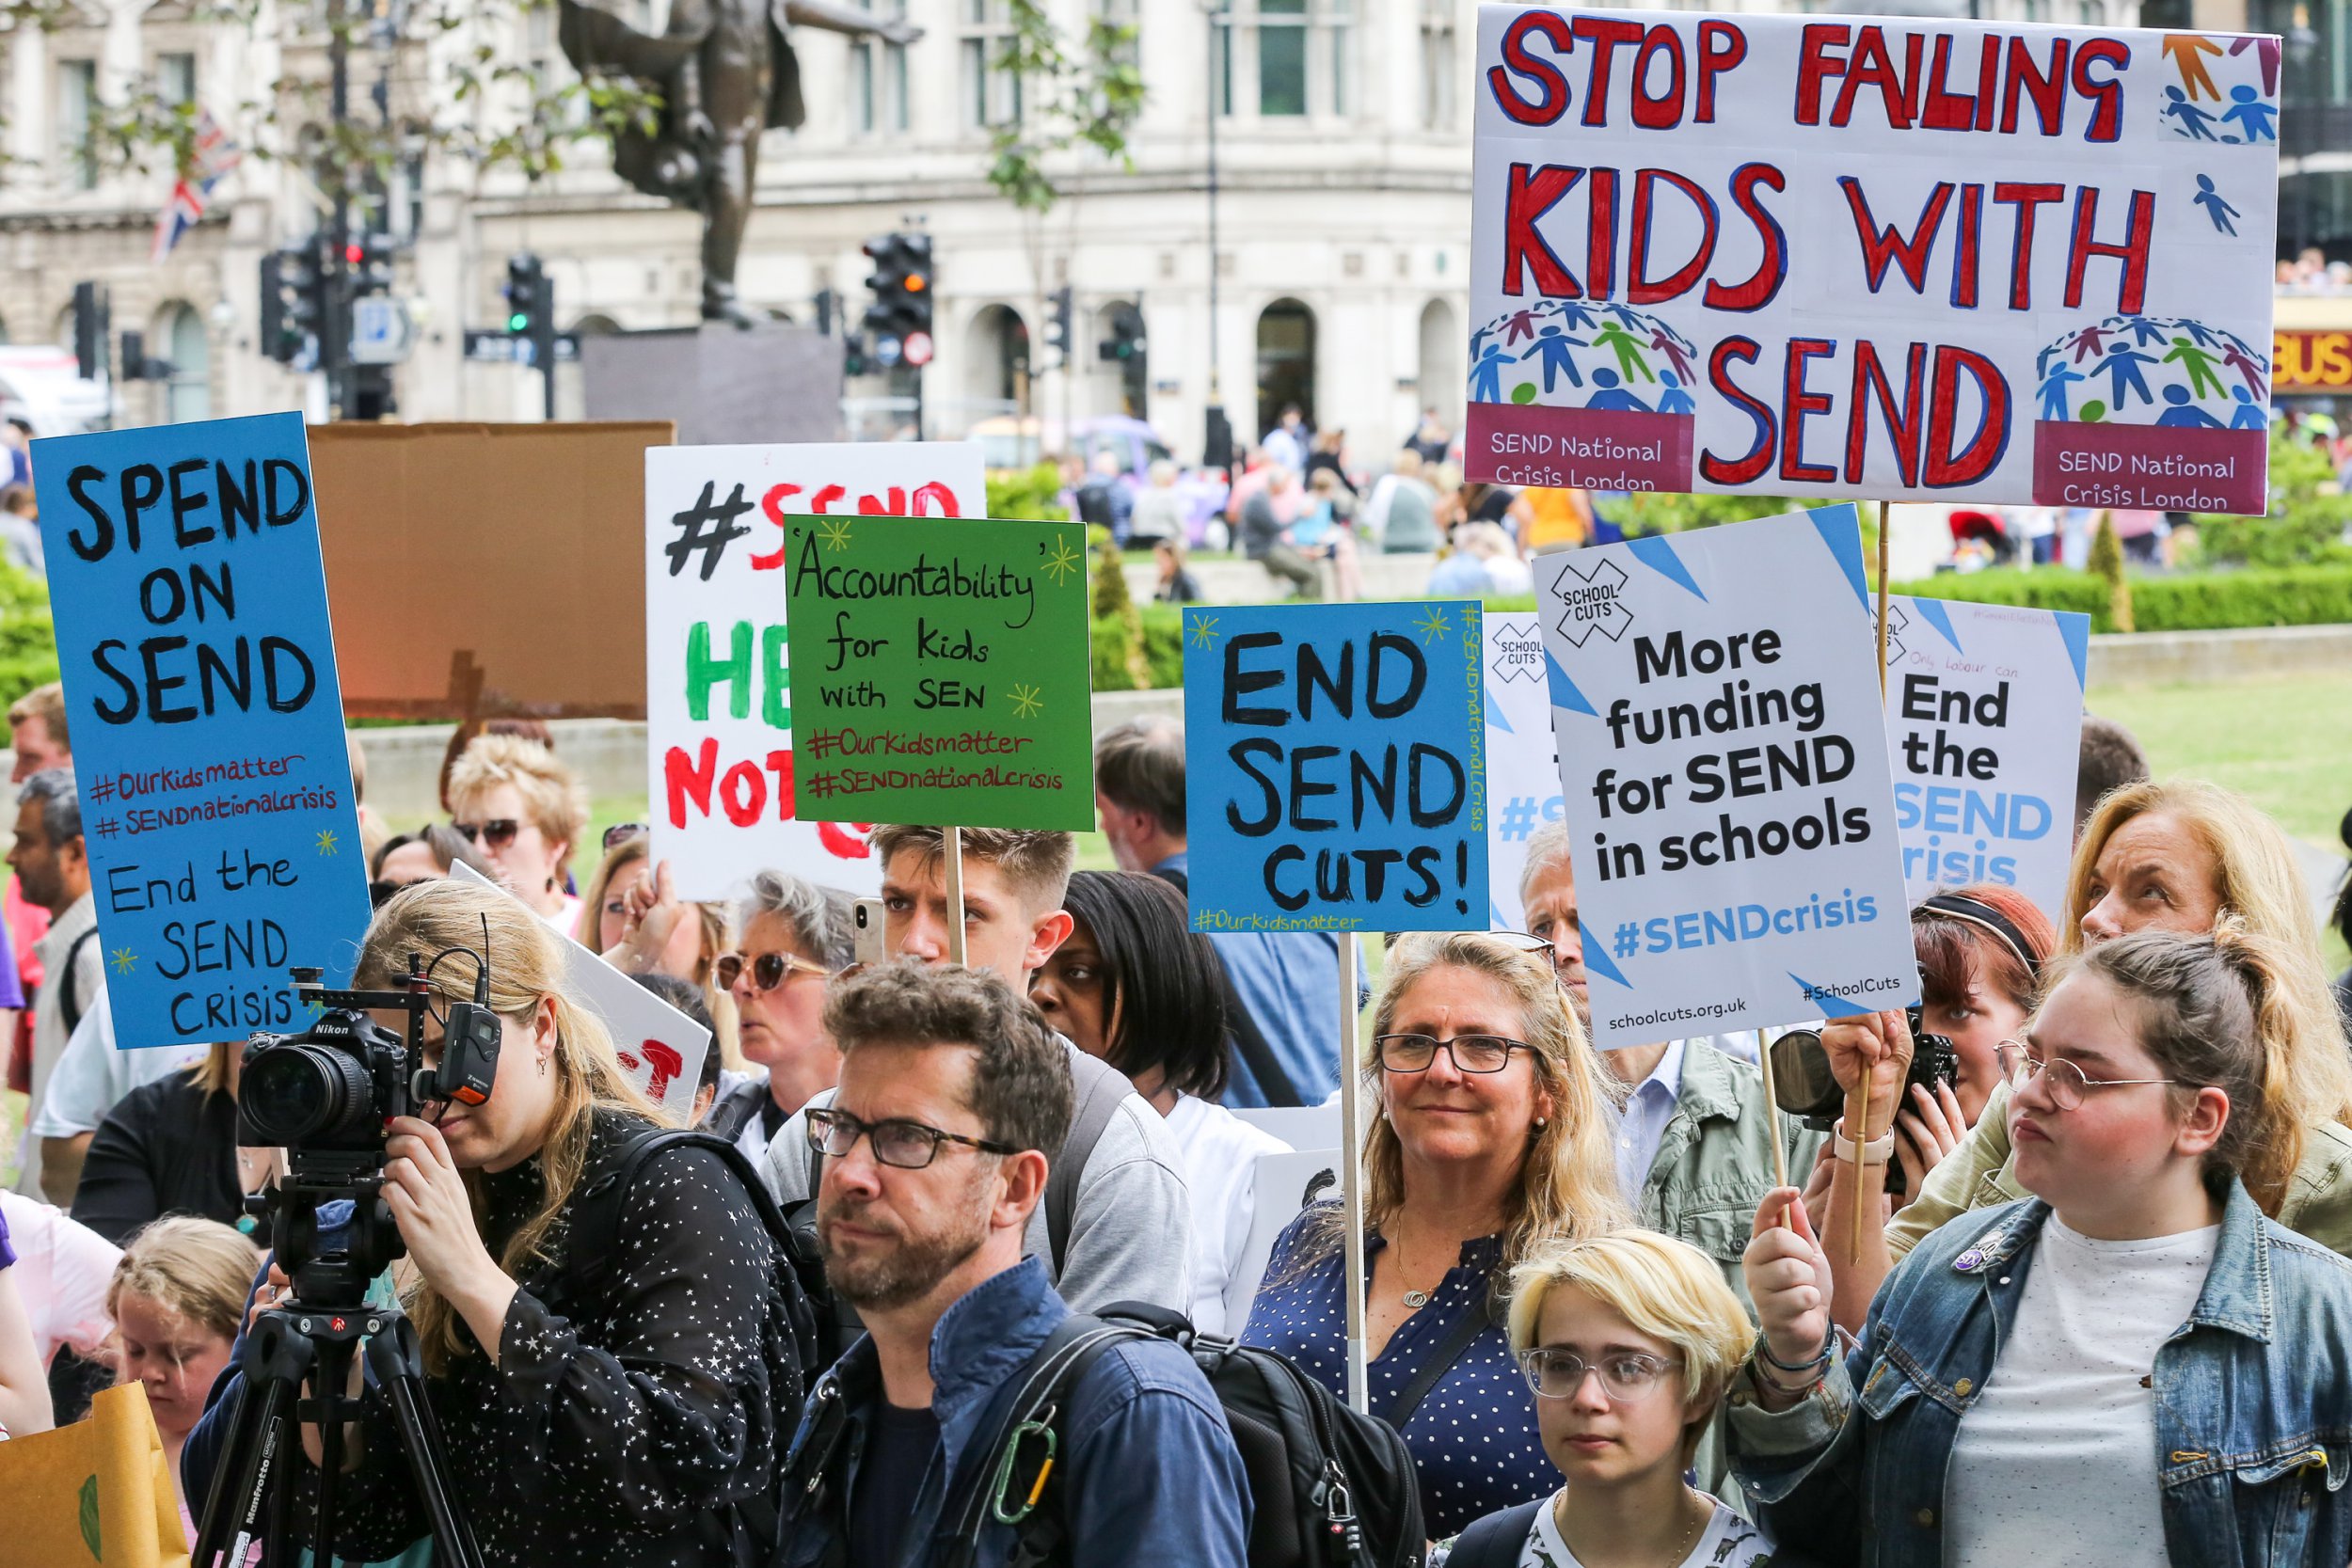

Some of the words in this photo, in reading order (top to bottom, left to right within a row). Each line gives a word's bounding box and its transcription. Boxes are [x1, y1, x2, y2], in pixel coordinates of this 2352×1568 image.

[1486, 9, 1748, 129] STOP
[1795, 23, 2131, 143] FAILING
[1502, 162, 1788, 311] KIDS
[1836, 175, 2155, 315] WITH
[1699, 334, 2012, 490] SEND
[1490, 432, 1553, 455] SEND
[1561, 436, 1661, 462] National
[2058, 451, 2122, 473] SEND
[2131, 454, 2234, 479] National
[1496, 465, 1563, 486] Crisis
[1570, 468, 1656, 492] London
[2063, 483, 2133, 506] Crisis
[2140, 486, 2228, 510] London
[66, 458, 310, 562] SPEND
[139, 561, 235, 625] ON
[1563, 584, 1619, 607] SCHOOL
[1574, 602, 1613, 622] CUTS
[826, 611, 888, 672] for
[1501, 641, 1543, 653] SCHOOL
[1507, 654, 1536, 664] CUTS
[1632, 629, 1783, 685] More
[1910, 651, 1935, 671] Only
[1946, 657, 1986, 673] Labour
[1994, 666, 2019, 678] can
[91, 634, 316, 724] SEND
[820, 681, 886, 709] with
[913, 678, 985, 709] SEN
[1221, 631, 1427, 727] END
[1901, 673, 2010, 728] End
[1606, 679, 1826, 750] funding
[1592, 769, 1675, 819] for
[1686, 734, 1856, 803] SEND
[1901, 729, 1999, 781] the
[1225, 737, 1467, 837] SEND
[1894, 783, 2053, 841] SEND
[1594, 832, 1646, 881] in
[1659, 798, 1871, 872] schools
[1902, 835, 2017, 886] risis
[107, 854, 197, 914] End
[215, 848, 299, 892] the
[1263, 837, 1469, 915] CUTS!
[155, 918, 288, 980] SEND
[1613, 887, 1878, 958] #SENDcrisis
[1609, 998, 1747, 1031] schoolcuts.org.uk
[1802, 976, 1900, 1002] #SchoolCuts
[315, 1024, 349, 1035] Nikon
[246, 1459, 270, 1525] Manfrotto
